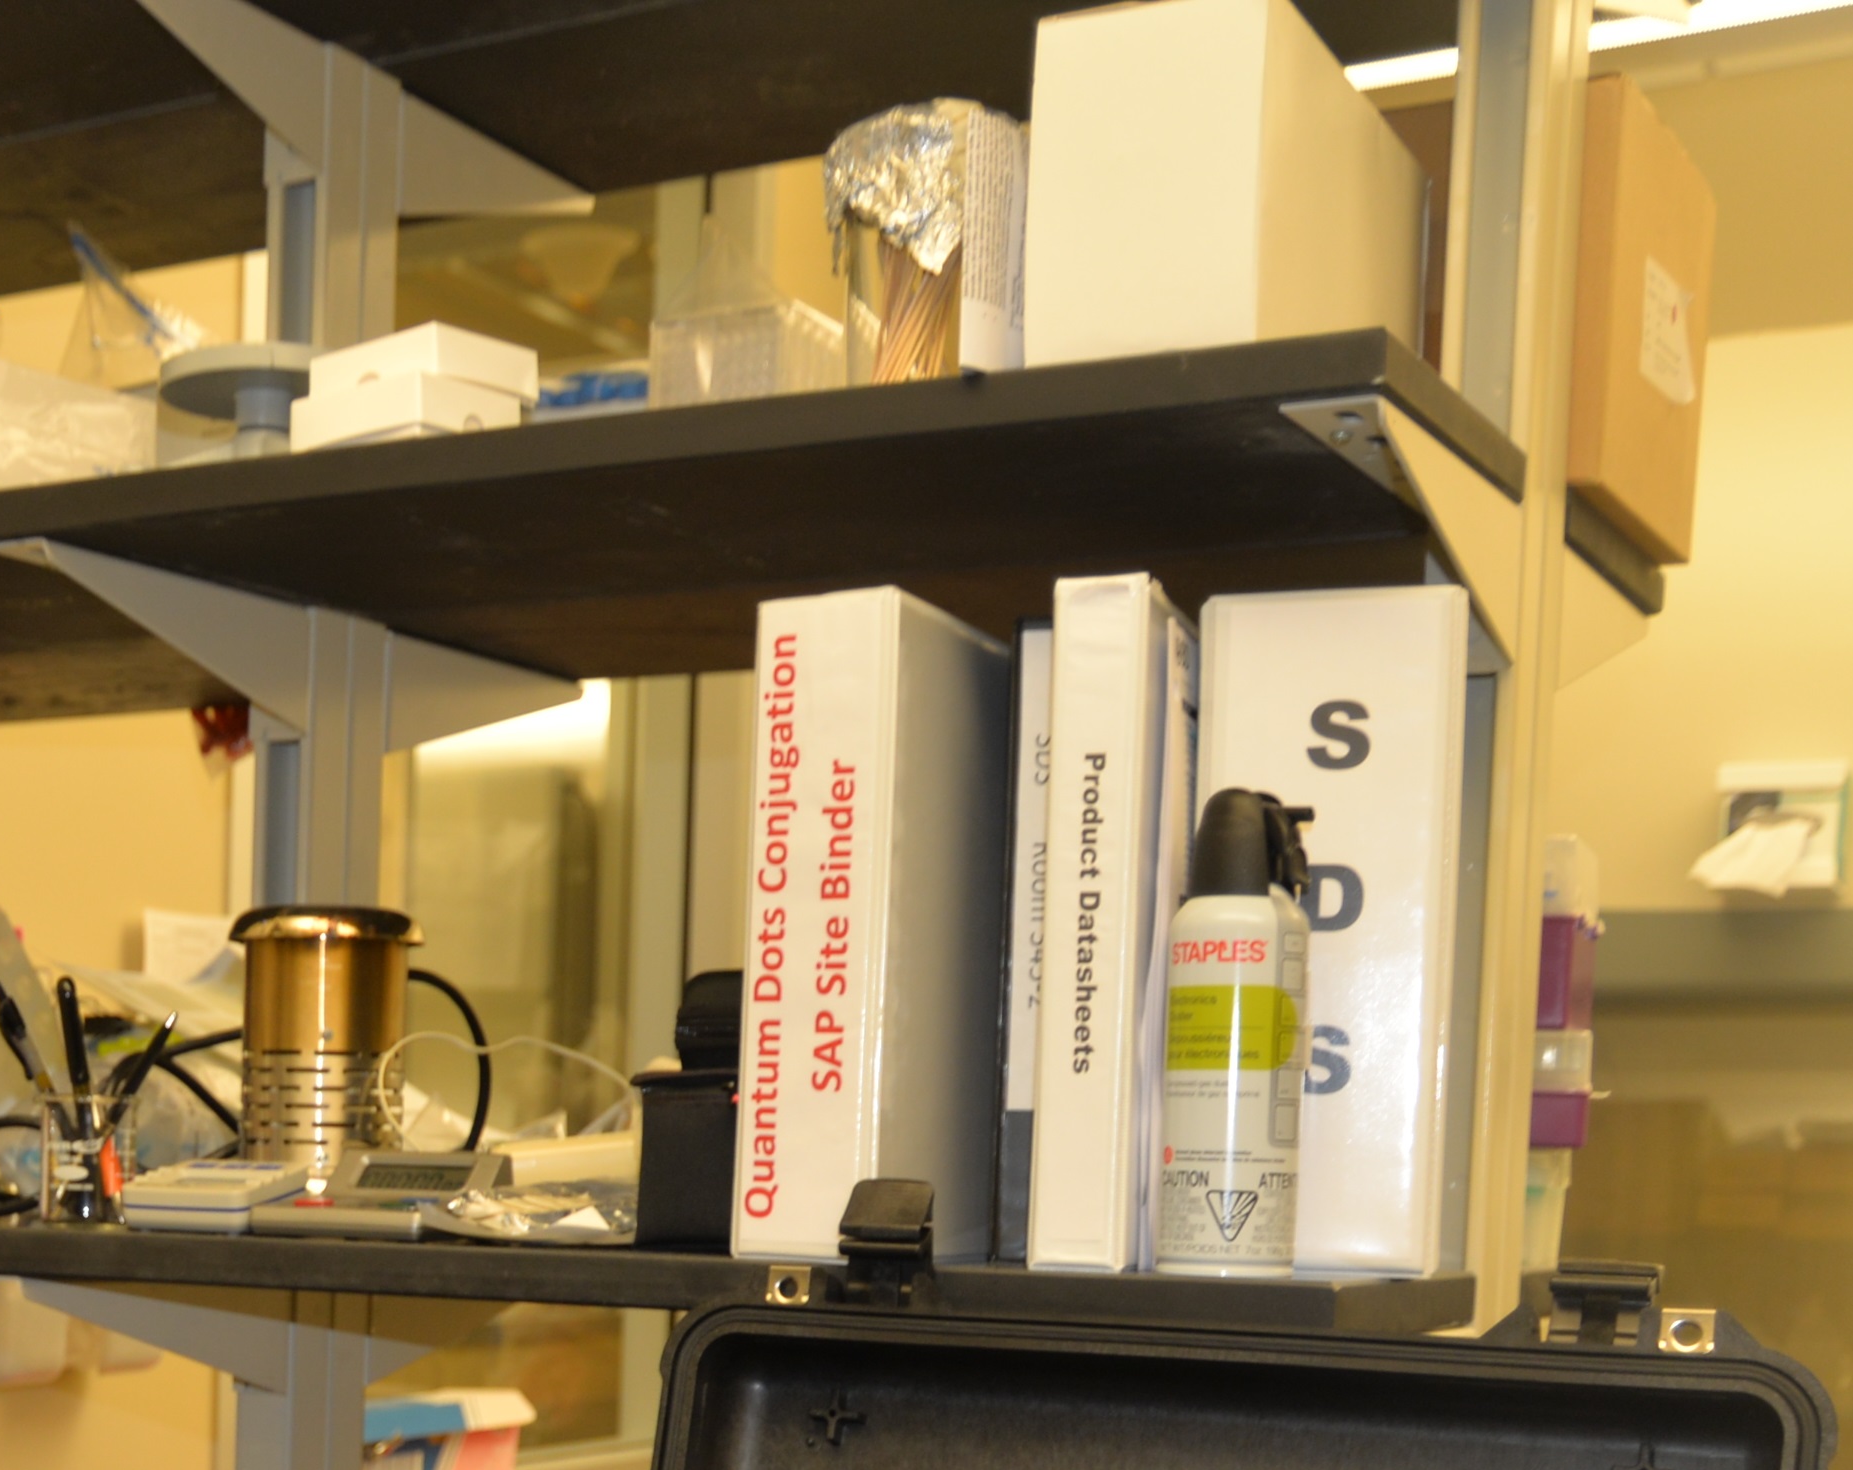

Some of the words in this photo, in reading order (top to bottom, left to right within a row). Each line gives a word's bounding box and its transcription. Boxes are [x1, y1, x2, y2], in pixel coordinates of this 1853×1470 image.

[757, 634, 800, 895] Conjugation
[1080, 753, 1106, 880] Product
[820, 760, 856, 902] Binder
[753, 908, 786, 1004] Dots
[817, 917, 848, 998] Site
[1073, 892, 1101, 1075] Datasheets
[1172, 939, 1267, 965] STAPLES
[811, 1010, 843, 1093] SAP
[744, 1020, 782, 1219] Quantum
